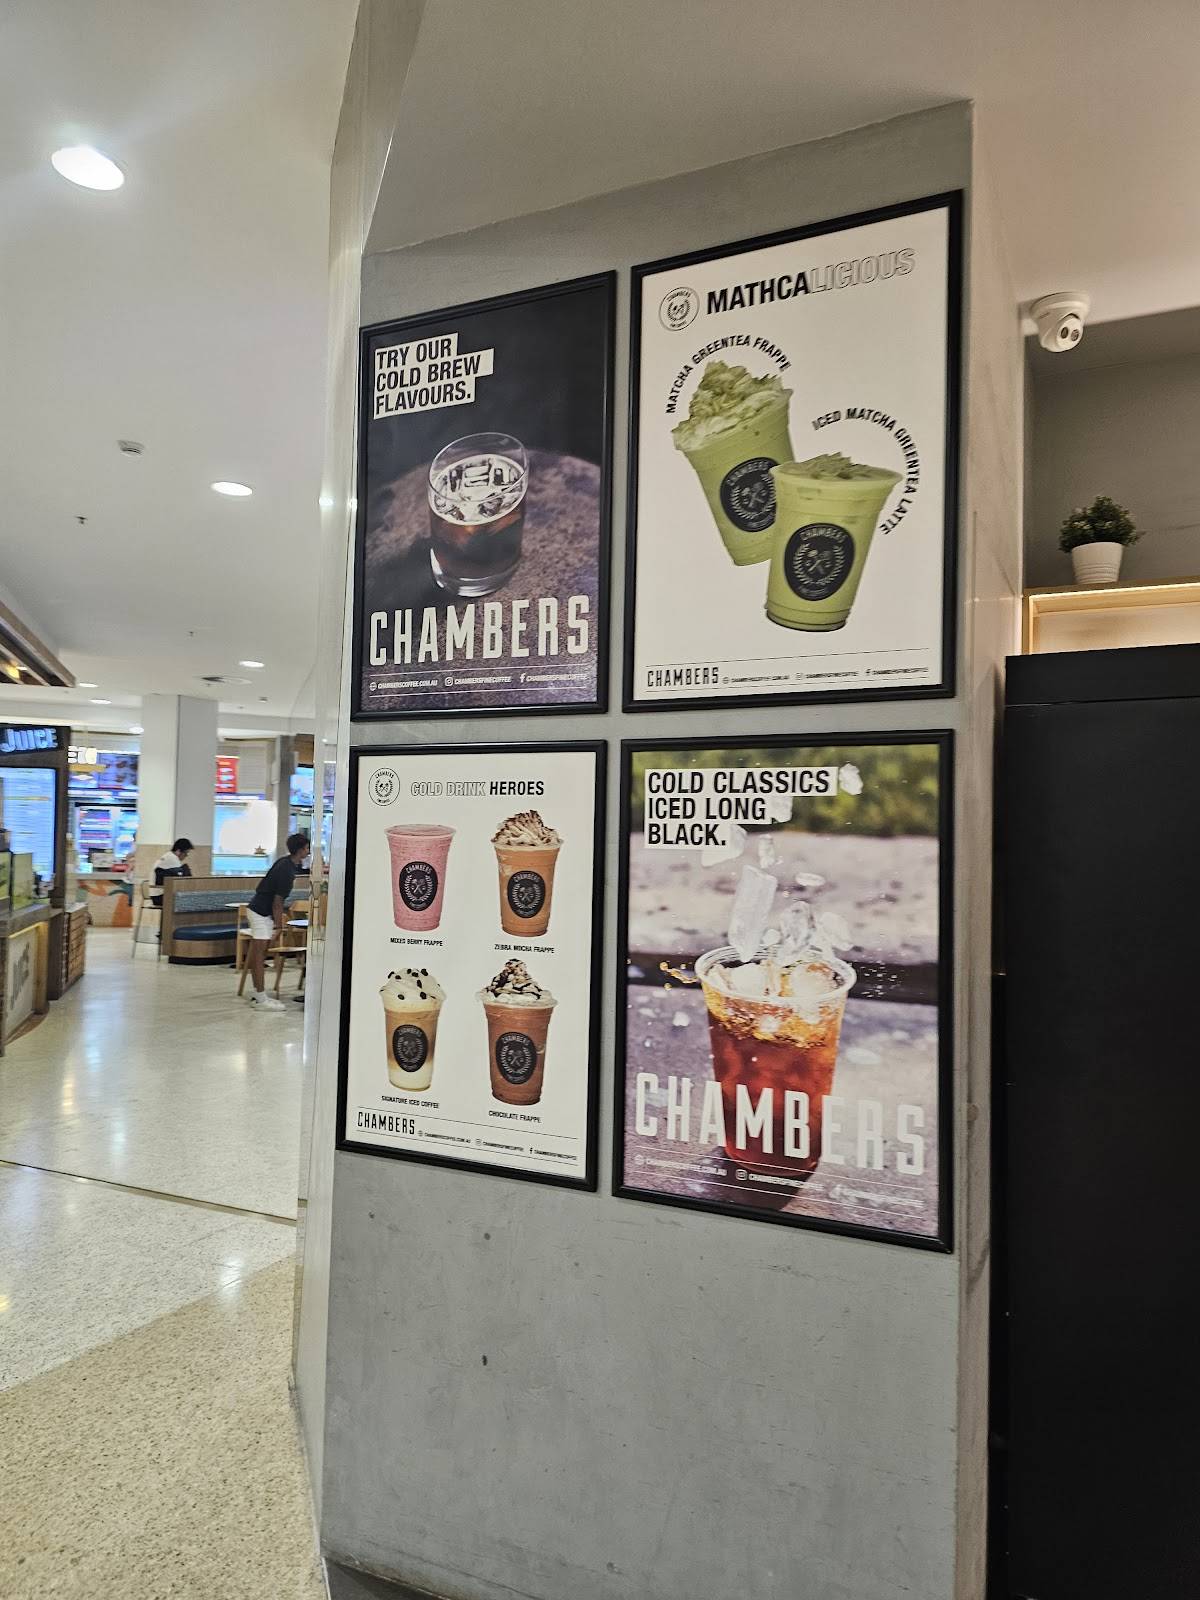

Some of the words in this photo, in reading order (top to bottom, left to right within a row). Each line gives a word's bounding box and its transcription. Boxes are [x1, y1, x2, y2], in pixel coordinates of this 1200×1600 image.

[376, 346, 410, 370] TRY
[415, 338, 452, 363] OUR
[376, 367, 421, 392] COLD
[427, 354, 481, 383] BREW
[665, 365, 694, 414] MATCHA
[692, 335, 751, 365] GREENTEA
[375, 380, 471, 415] FLAVOURS.
[811, 409, 842, 431] ICED
[845, 407, 896, 432] MATCHA
[879, 498, 913, 536] LATTE
[369, 594, 590, 666] CHAMBERS
[646, 666, 719, 687] CHAMBERS
[0, 728, 58, 753] JUICE
[410, 781, 443, 797] COLD
[446, 781, 486, 797] DRINK
[489, 781, 545, 796] HEROES
[648, 771, 704, 794] COLD
[713, 770, 830, 794] CLASSICS
[648, 797, 696, 820] ICED
[705, 797, 766, 821] LONG
[647, 823, 726, 846] BLACK.
[423, 939, 443, 947] FRAPPE
[533, 946, 555, 954] FRAPPE
[381, 1095, 408, 1105] SIGNATURE
[420, 1100, 439, 1109] COFFEE
[357, 1111, 415, 1135] CHAMBERS
[488, 1110, 518, 1120] CHOCOLATE
[635, 1072, 925, 1176] CHAMBERS
